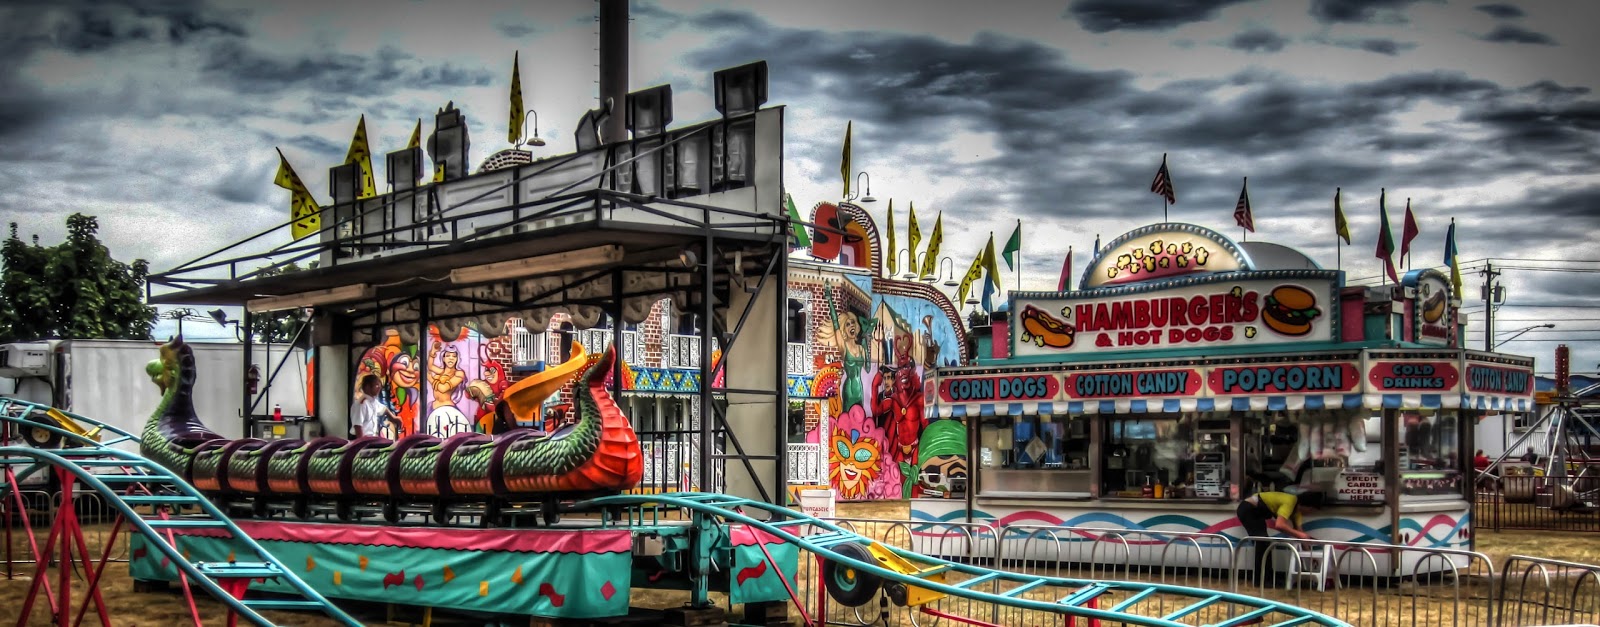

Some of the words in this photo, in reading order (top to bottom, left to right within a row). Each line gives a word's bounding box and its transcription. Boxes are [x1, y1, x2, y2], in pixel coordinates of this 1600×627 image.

[1075, 290, 1259, 333] HAMBURGERS
[1094, 332, 1114, 348] &
[1117, 328, 1163, 346] HOT
[1168, 325, 1234, 344] DOGS
[1222, 364, 1343, 392] POPCORN
[1382, 376, 1445, 389] DRINKS
[1392, 364, 1435, 377] COLD
[1469, 366, 1503, 391] COTTON
[1503, 370, 1529, 393] CANDY
[949, 379, 995, 401] CORN
[999, 376, 1048, 399] DOGS
[1075, 373, 1134, 397] COTTON
[1136, 371, 1189, 395] CANDY
